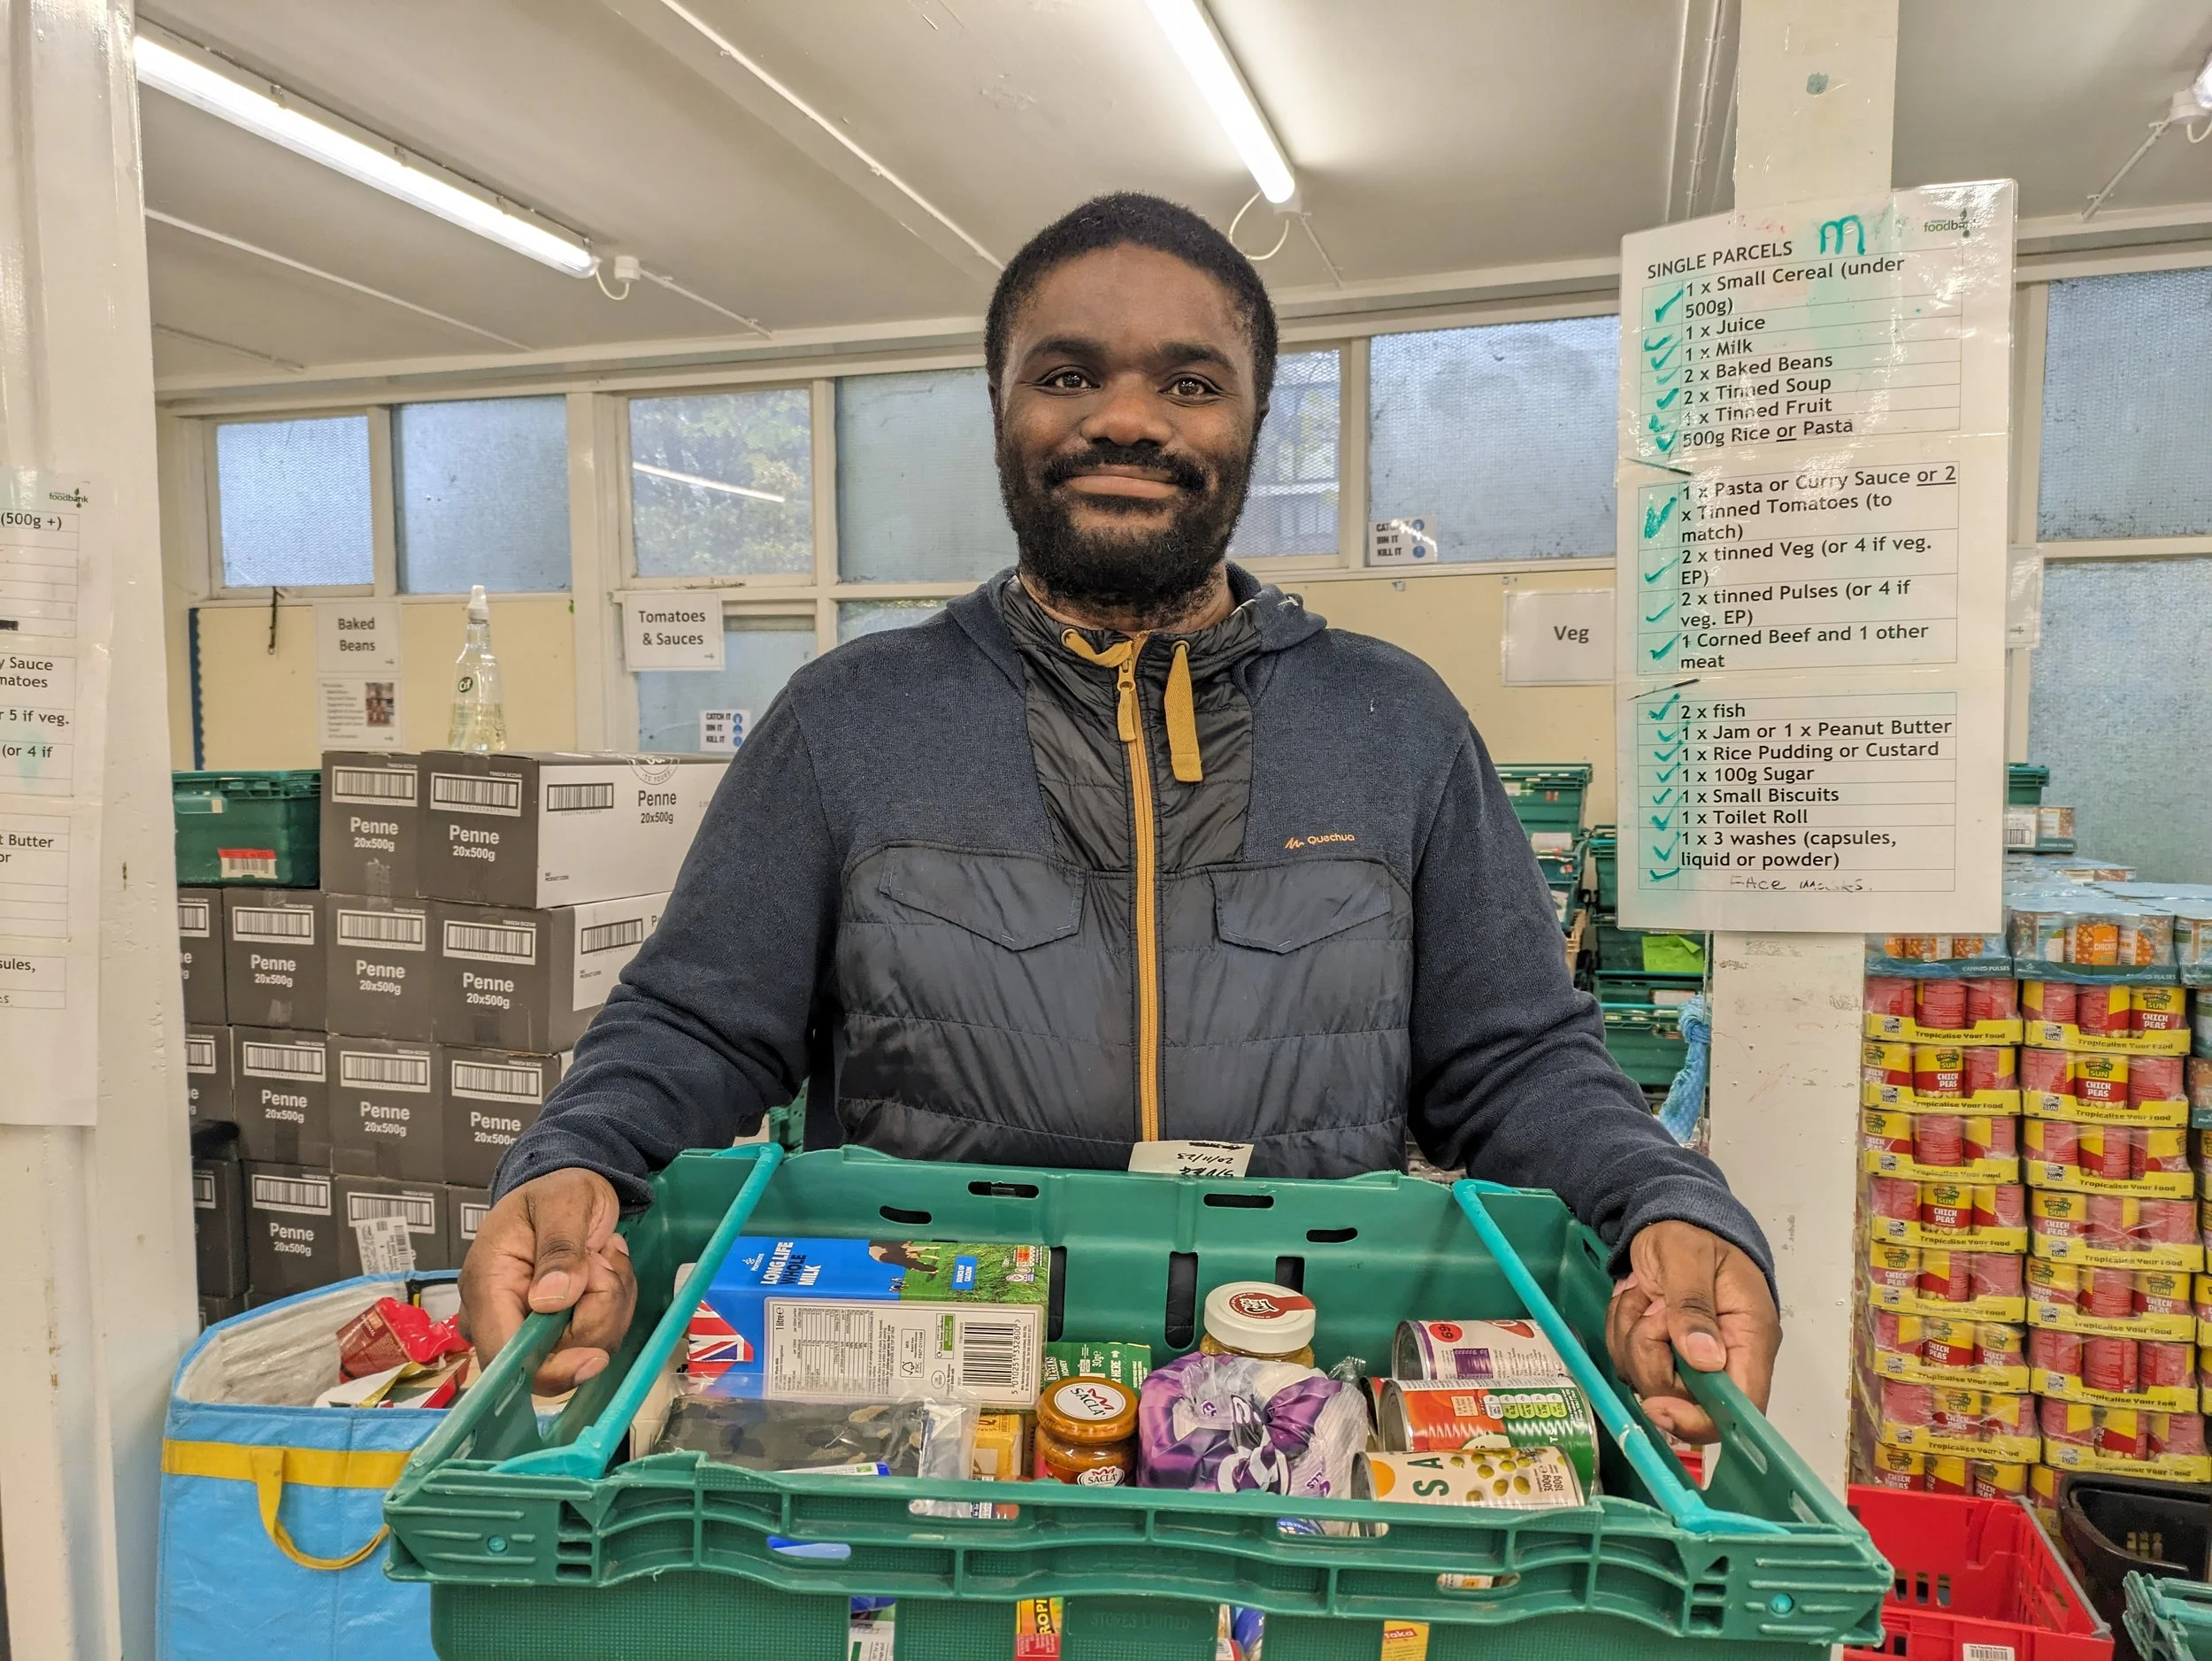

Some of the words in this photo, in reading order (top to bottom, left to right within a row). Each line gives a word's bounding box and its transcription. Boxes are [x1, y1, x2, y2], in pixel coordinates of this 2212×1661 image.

[1647, 254, 1707, 280] SINGLE
[1712, 241, 1793, 266] PARCELS
[1717, 272, 1766, 292] Small
[1772, 265, 1833, 284] Cereal
[1840, 258, 1905, 280] (under
[1686, 297, 1733, 319] 500g)
[1717, 317, 1766, 335] Juice
[1717, 340, 1753, 357] Milk
[1717, 359, 1771, 379] Baked
[1778, 353, 1833, 373] Beans
[1716, 378, 1779, 400] Tinned
[1786, 376, 1832, 396] Soup
[1716, 400, 1779, 422] Tinned
[1786, 398, 1832, 415] Fruit
[1683, 432, 1724, 449] 500g
[1732, 426, 1770, 442] Rice
[1777, 425, 1796, 441] or
[1804, 419, 1854, 436] Pasta
[1715, 480, 1763, 497] Pasta
[1770, 479, 1789, 493] or
[1795, 473, 1847, 493] Curry
[1855, 469, 1910, 487] Sauce
[1917, 469, 1937, 484] or
[1946, 465, 1956, 481] 2
[1697, 500, 1761, 521] Tinned
[1767, 494, 1859, 514] Tomatoes
[1866, 493, 1893, 512] (to
[1, 512, 41, 529] (500g
[47, 516, 63, 531] +)
[1681, 523, 1744, 544] match)
[1714, 543, 1773, 562] tinned
[1779, 541, 1815, 558] Veg
[1822, 539, 1848, 558] (or
[1855, 538, 1866, 553] 4
[1872, 536, 1886, 552] if
[1893, 537, 1932, 553] veg.
[1681, 569, 1709, 588] EP)
[1714, 586, 1772, 604] tinned
[1779, 584, 1838, 600] Pulses
[1846, 581, 1872, 601] (or
[1878, 581, 1890, 596] 4
[1897, 580, 1911, 595] if
[338, 618, 375, 631] Baked
[638, 610, 706, 624] Tomatoes
[1681, 614, 1717, 630] veg.
[1724, 610, 1754, 627] EP)
[642, 633, 652, 646] &
[657, 632, 703, 647] Sauces
[1553, 625, 1589, 643] Veg
[1683, 634, 1691, 648] 1
[1697, 632, 1763, 648] Corned
[1769, 627, 1811, 643] Beef
[1817, 626, 1851, 642] and
[1860, 627, 1867, 641] 1
[1876, 625, 1929, 640] other
[340, 639, 375, 652] Beans
[10, 657, 53, 671] Sauce
[1681, 654, 1725, 670] meat
[458, 679, 472, 692] Cif
[10, 710, 17, 720] 5
[23, 711, 34, 722] if
[39, 714, 69, 727] veg.
[1713, 703, 1746, 719] fish
[1713, 725, 1750, 740] Jam
[1756, 725, 1777, 738] or
[1818, 720, 1886, 736] Peanut
[1891, 719, 1953, 734] Butter
[3, 745, 22, 757] (or
[27, 746, 36, 757] 4
[42, 746, 53, 757] if
[1713, 746, 1752, 761] Rice
[1758, 743, 1833, 763] Pudding
[1839, 745, 1859, 757] or
[1866, 741, 1939, 757] Custard
[1715, 767, 1757, 786] 100g
[1763, 765, 1815, 785] Sugar
[638, 790, 677, 807] Penne
[1713, 788, 1762, 804] Small
[1768, 787, 1839, 804] Biscuits
[350, 817, 398, 835] Penne
[641, 812, 673, 824] 20x500g
[1713, 810, 1767, 825] Toilet
[1773, 809, 1808, 824] Roll
[9, 835, 54, 848] Butter
[449, 825, 499, 844] Penne
[1307, 833, 1355, 845] Quechua
[1714, 831, 1723, 846] 3
[1731, 829, 1796, 846] washes
[1803, 829, 1897, 851] (capsules,
[354, 837, 395, 852] 20x500g
[453, 845, 495, 862] 20x500g
[1681, 851, 1731, 871] liquid
[1736, 853, 1755, 867] or
[1763, 850, 1840, 871] powder)
[250, 954, 296, 973] Penne
[356, 960, 406, 980] Penne
[359, 980, 402, 996] 20x500g
[462, 972, 515, 993] Penne
[466, 993, 511, 1010] 20x500g
[2143, 1013, 2168, 1022] CHICK
[261, 1089, 308, 1108] Penne
[265, 1108, 304, 1124] 20x500g
[359, 1101, 411, 1120] Penne
[364, 1121, 407, 1137] 20x500g
[470, 1111, 521, 1131] Penne
[2079, 1180, 2129, 1189] Tropicalise
[1936, 1215, 1955, 1224] PEAS
[269, 1222, 315, 1242] Penne
[1920, 1236, 1966, 1245] Tropicalise
[273, 1241, 311, 1257] 20x500g
[772, 1242, 794, 1260] LIFE
[760, 1261, 786, 1285] LONG
[780, 1255, 806, 1285] WHOLE
[797, 1265, 821, 1285] MILK
[1111, 1359, 1121, 1378] HERE
[1542, 1474, 1553, 1492] 300g
[1553, 1475, 1563, 1491] 180g
